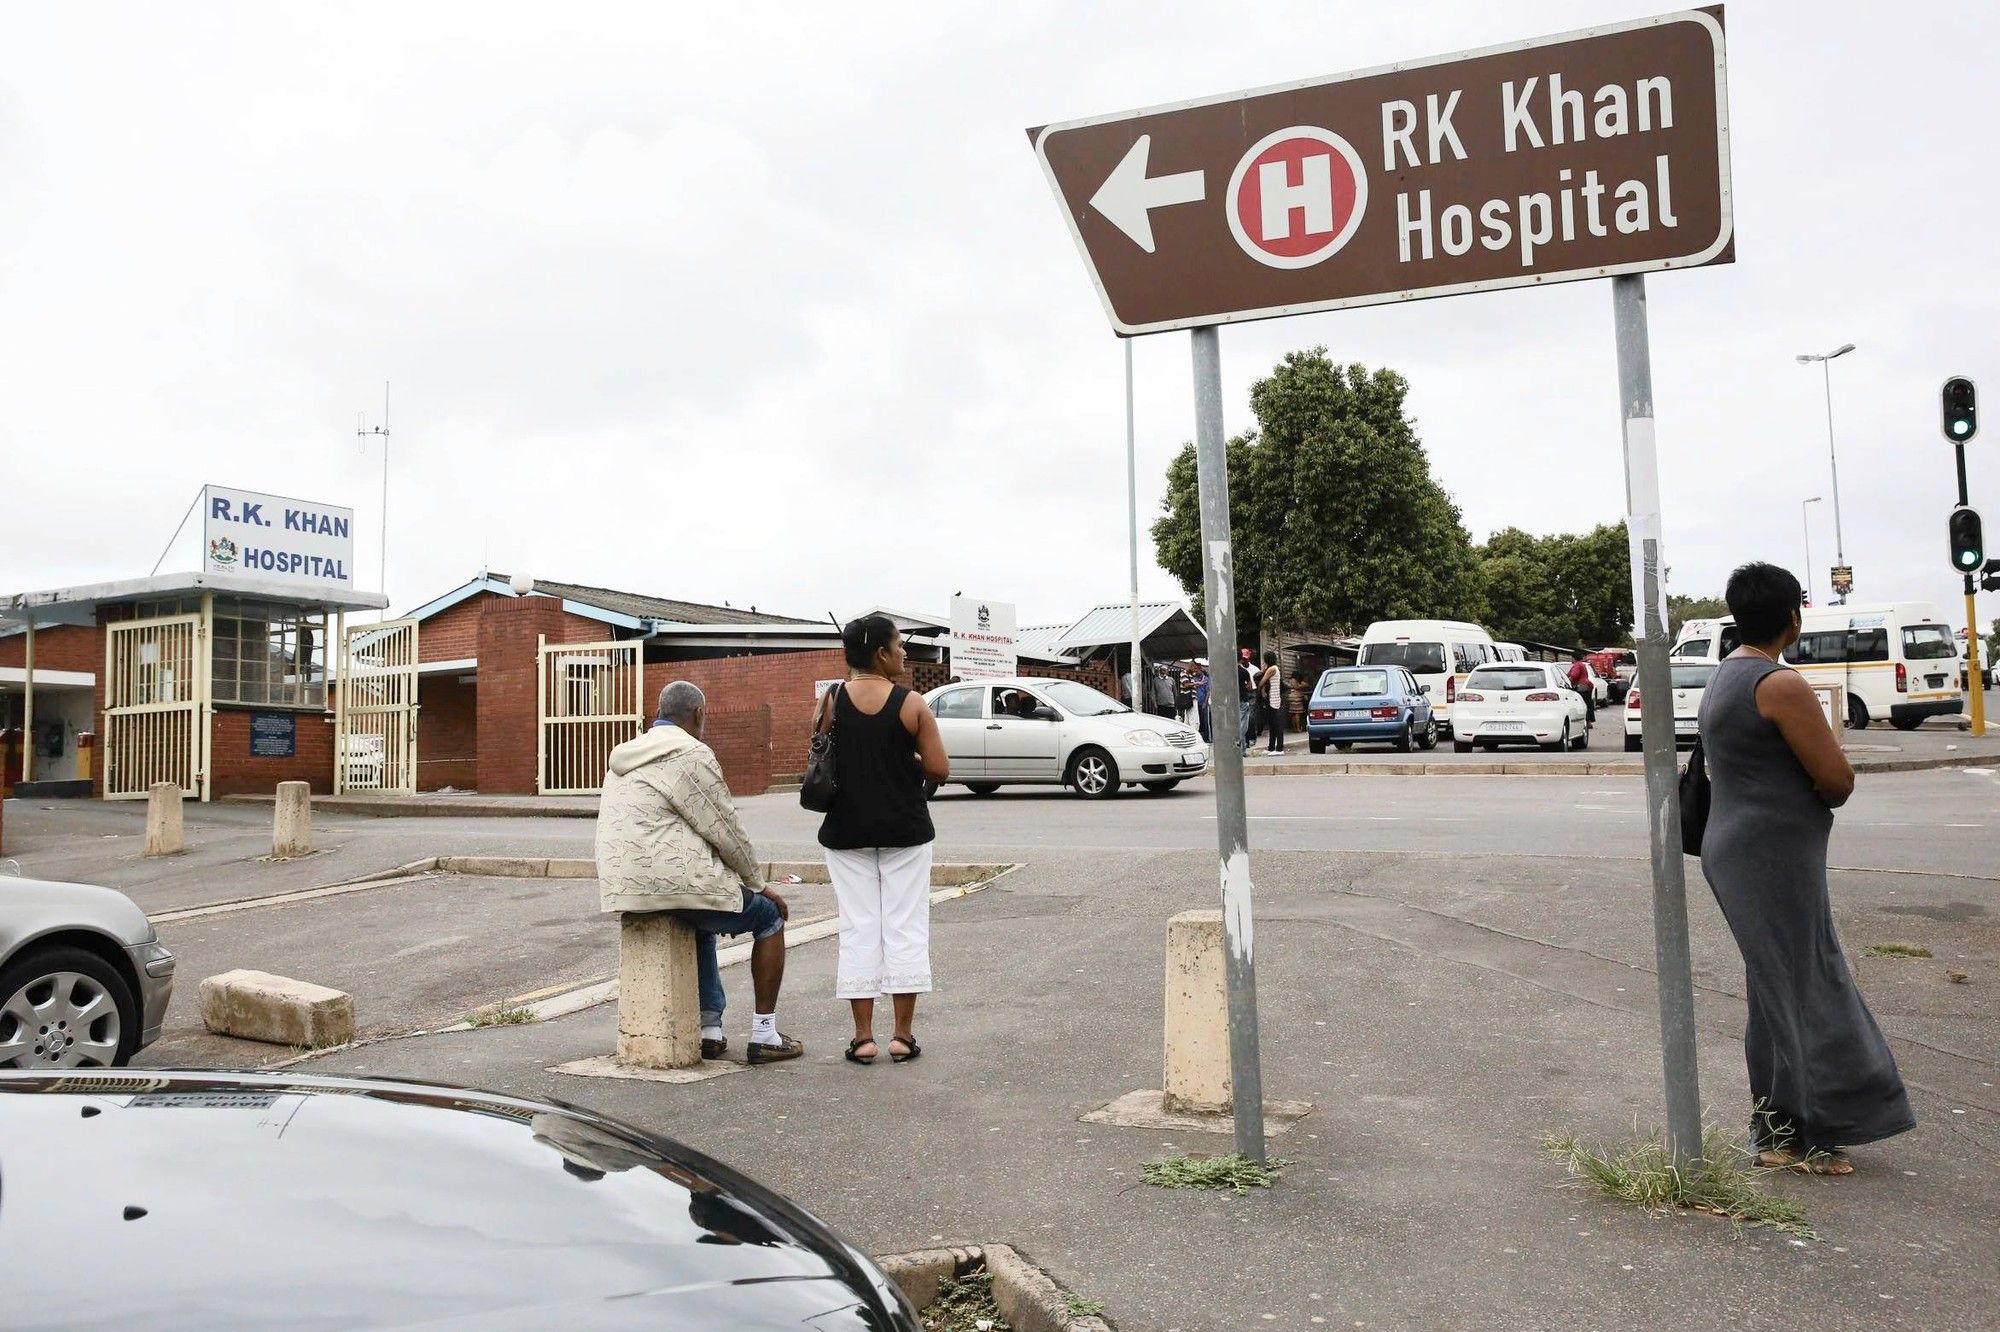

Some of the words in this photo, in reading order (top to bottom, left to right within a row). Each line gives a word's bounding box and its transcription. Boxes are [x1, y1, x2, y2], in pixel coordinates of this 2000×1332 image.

[1381, 90, 1469, 172] RK
[1502, 73, 1674, 152] Khan
[1259, 153, 1334, 241] H
[1398, 155, 1678, 267] Hospital
[212, 497, 271, 527] R.K.
[285, 509, 348, 538] KHAN
[244, 547, 348, 580] HOSPITAL
[986, 635, 1013, 644] HOSPITAL
